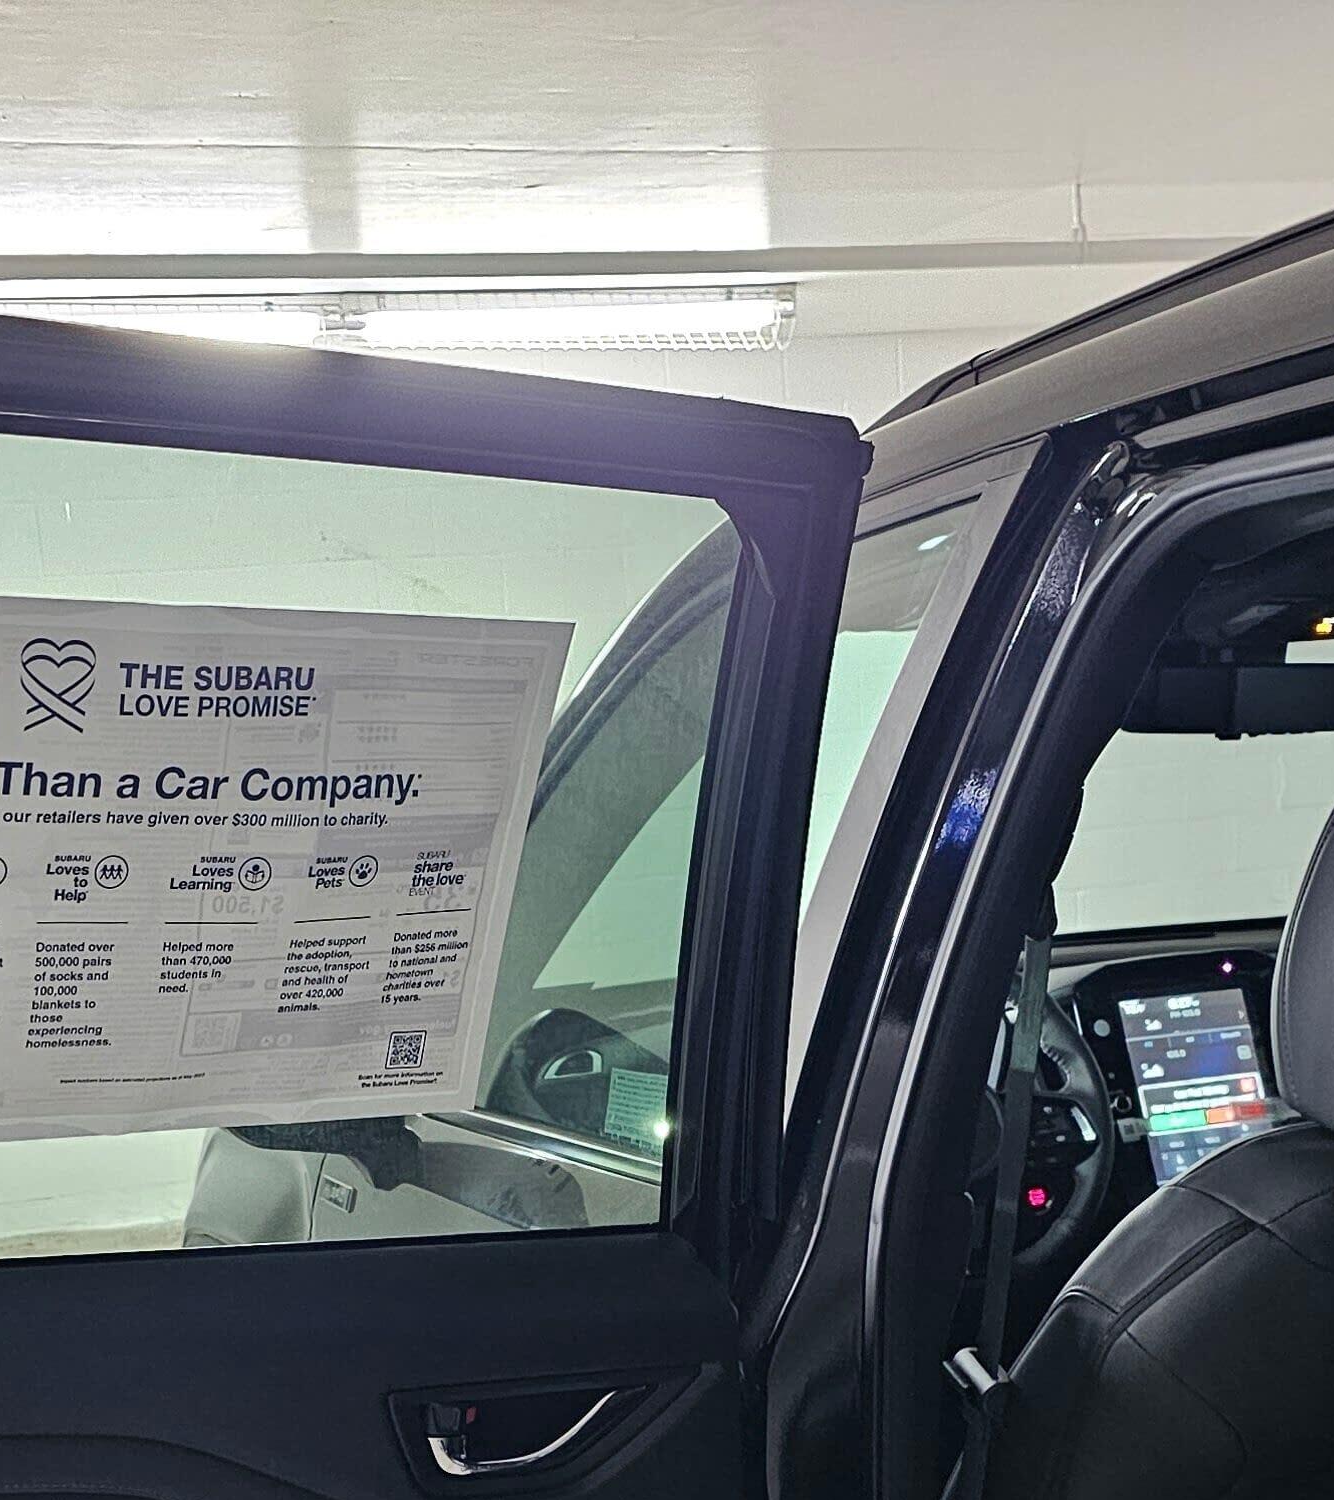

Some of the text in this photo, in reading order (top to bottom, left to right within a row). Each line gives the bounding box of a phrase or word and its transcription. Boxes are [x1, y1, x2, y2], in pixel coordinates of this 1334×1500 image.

[119, 662, 315, 691] THE SUBARU
[119, 693, 311, 718] LOVE PROMISE
[116, 774, 140, 799] a
[155, 766, 229, 800] Car
[3, 812, 32, 823] our
[36, 810, 101, 824] retailers
[106, 811, 143, 824] have
[147, 811, 189, 827] given
[194, 815, 229, 825] over
[232, 813, 267, 827] $300
[271, 814, 319, 827] million
[324, 814, 337, 826] to
[340, 812, 388, 828] charity.
[316, 856, 348, 864] SUBARU
[417, 850, 451, 860] SUBARU
[46, 863, 89, 875] Loves
[192, 864, 234, 877] Loves
[308, 866, 345, 878] Loves
[414, 860, 454, 873] share
[73, 876, 88, 888] to
[170, 877, 233, 893] Learning
[315, 877, 345, 889] Pets
[412, 872, 464, 887] the love
[54, 889, 86, 903] Help
[394, 930, 458, 942] Donated more
[36, 942, 115, 952] Donated over
[163, 942, 234, 954] Helped more
[289, 936, 366, 949] Helped support
[391, 946, 412, 955] than
[437, 941, 468, 951] million
[161, 955, 232, 966] than 470,000
[287, 949, 352, 961] the adoption,
[389, 953, 457, 968] to national and
[35, 956, 112, 969] 500,000 pairs
[284, 961, 370, 974] rescue, transport
[34, 970, 109, 982] of socks and
[160, 968, 221, 980] students in
[385, 969, 433, 980] hometown
[282, 974, 349, 987] and health of
[382, 979, 445, 992] charities over
[34, 985, 78, 997] 100,000
[158, 983, 188, 993] need.
[280, 987, 344, 1000] over 420,000
[32, 1000, 96, 1010] blankets to
[381, 994, 421, 1005] 15 years.
[277, 1002, 320, 1013] animals.
[30, 1014, 63, 1023] those
[28, 1025, 103, 1038] experiencing
[25, 1038, 111, 1048] homelessness.
